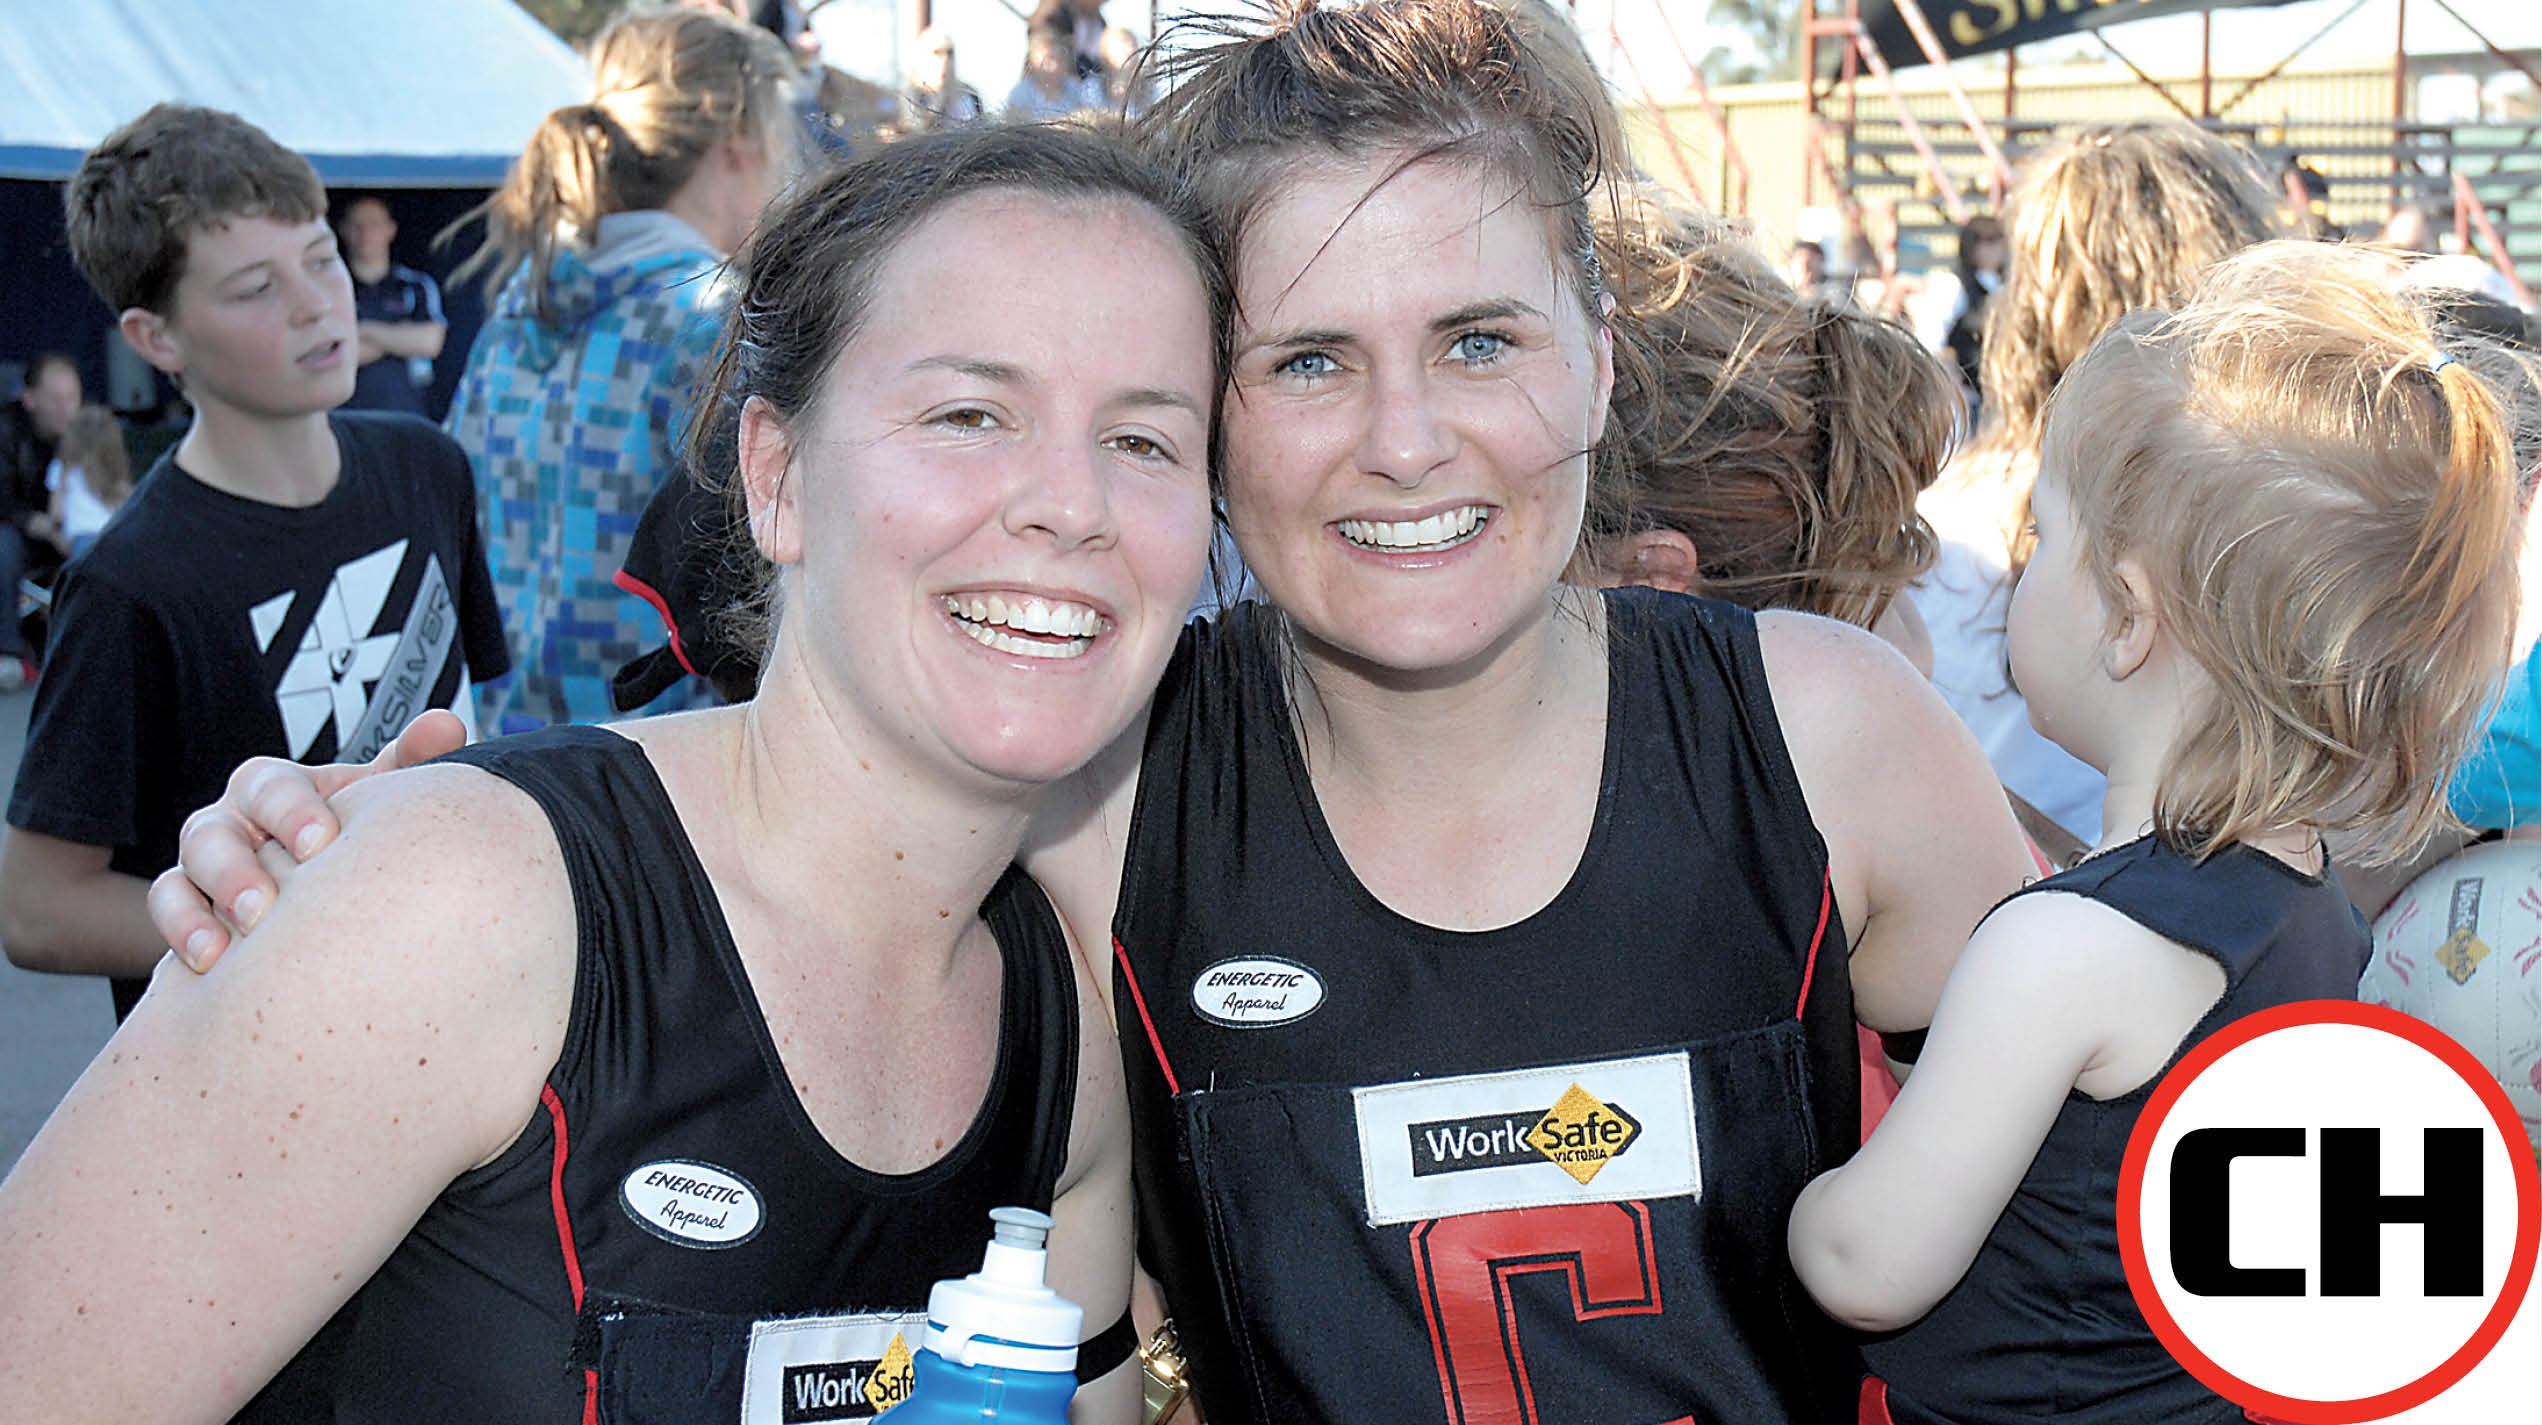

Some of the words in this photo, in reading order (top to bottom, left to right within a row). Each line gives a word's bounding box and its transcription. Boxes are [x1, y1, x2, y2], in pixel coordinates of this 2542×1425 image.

[356, 582, 448, 763] KSILVER
[1207, 972, 1304, 988] ENERGETIC
[1222, 992, 1288, 1016] Apparel
[1553, 1148, 1609, 1165] VICTORIA
[644, 1171, 744, 1205] ENERGETIC
[660, 1199, 729, 1230] Apparel
